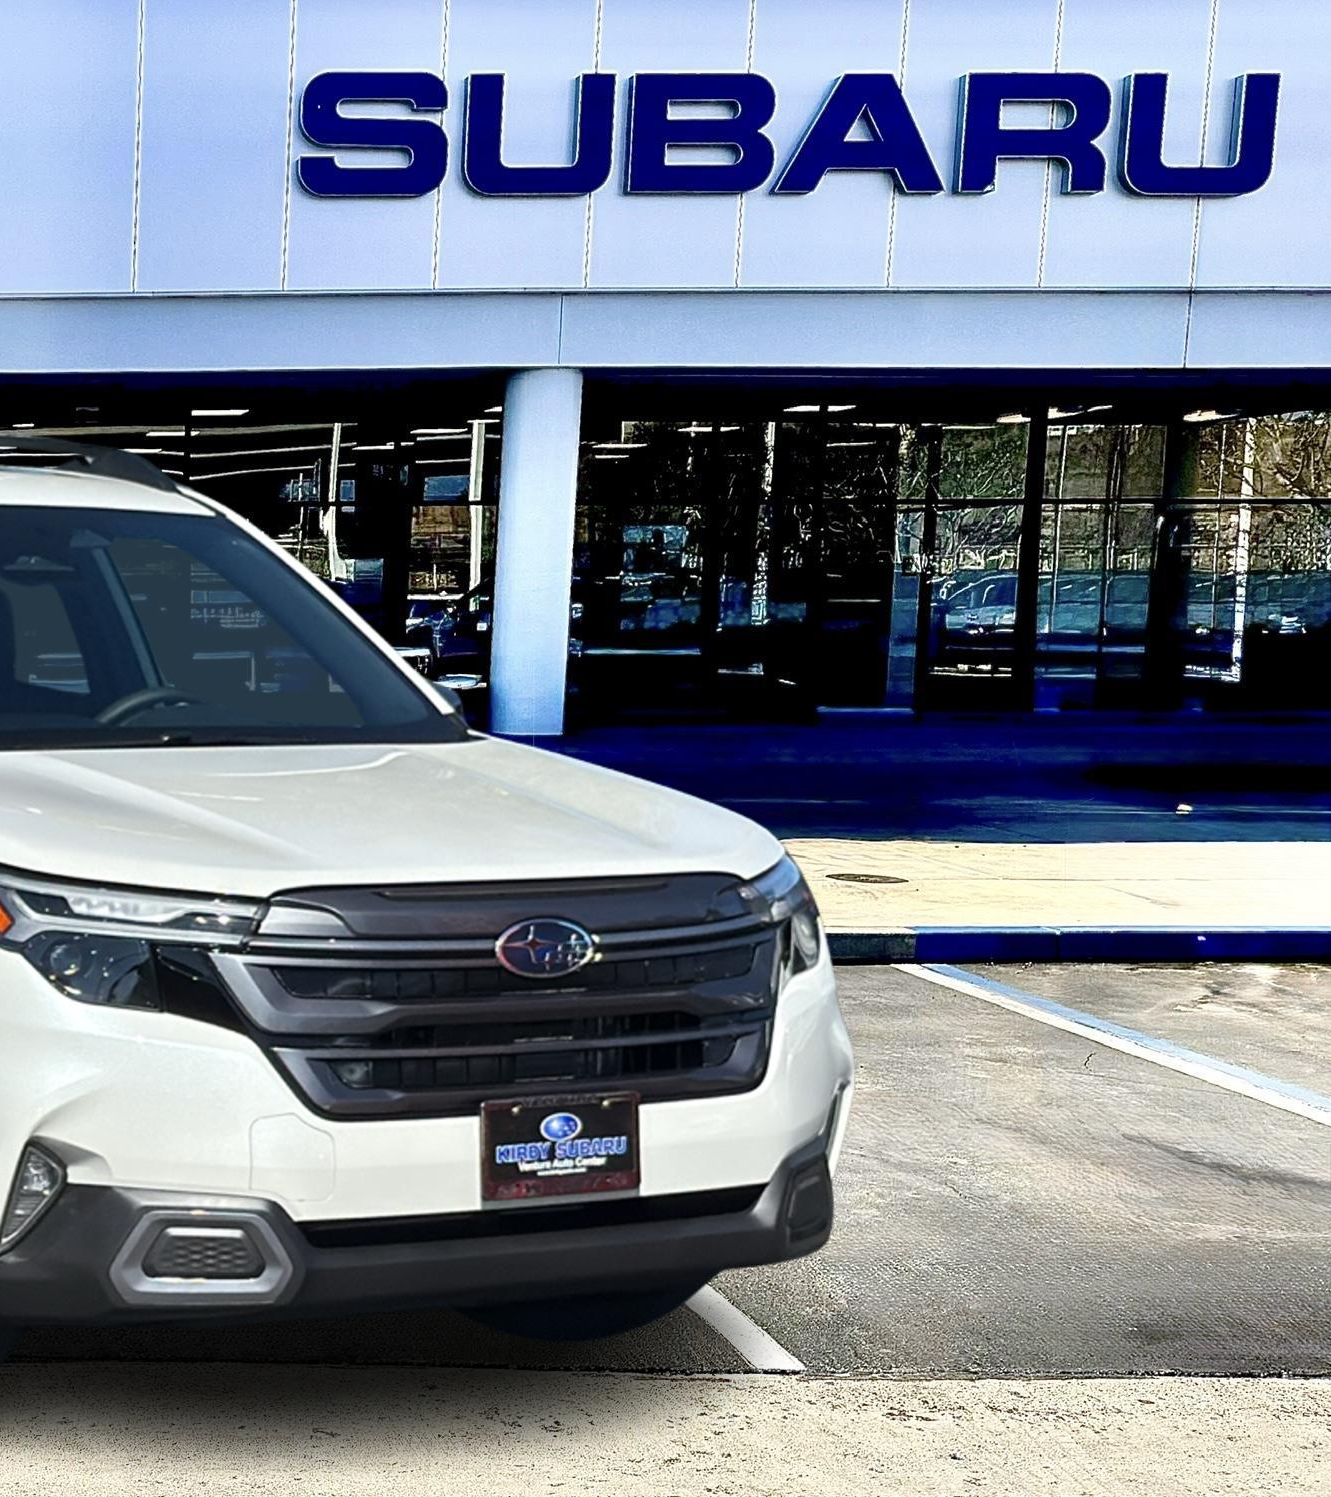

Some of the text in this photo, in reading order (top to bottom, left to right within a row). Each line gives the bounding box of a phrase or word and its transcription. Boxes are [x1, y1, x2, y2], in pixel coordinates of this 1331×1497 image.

[297, 71, 1281, 195] SUBARU
[495, 1136, 627, 1163] KIRBY SUBARU
[553, 1158, 574, 1168] Auto
